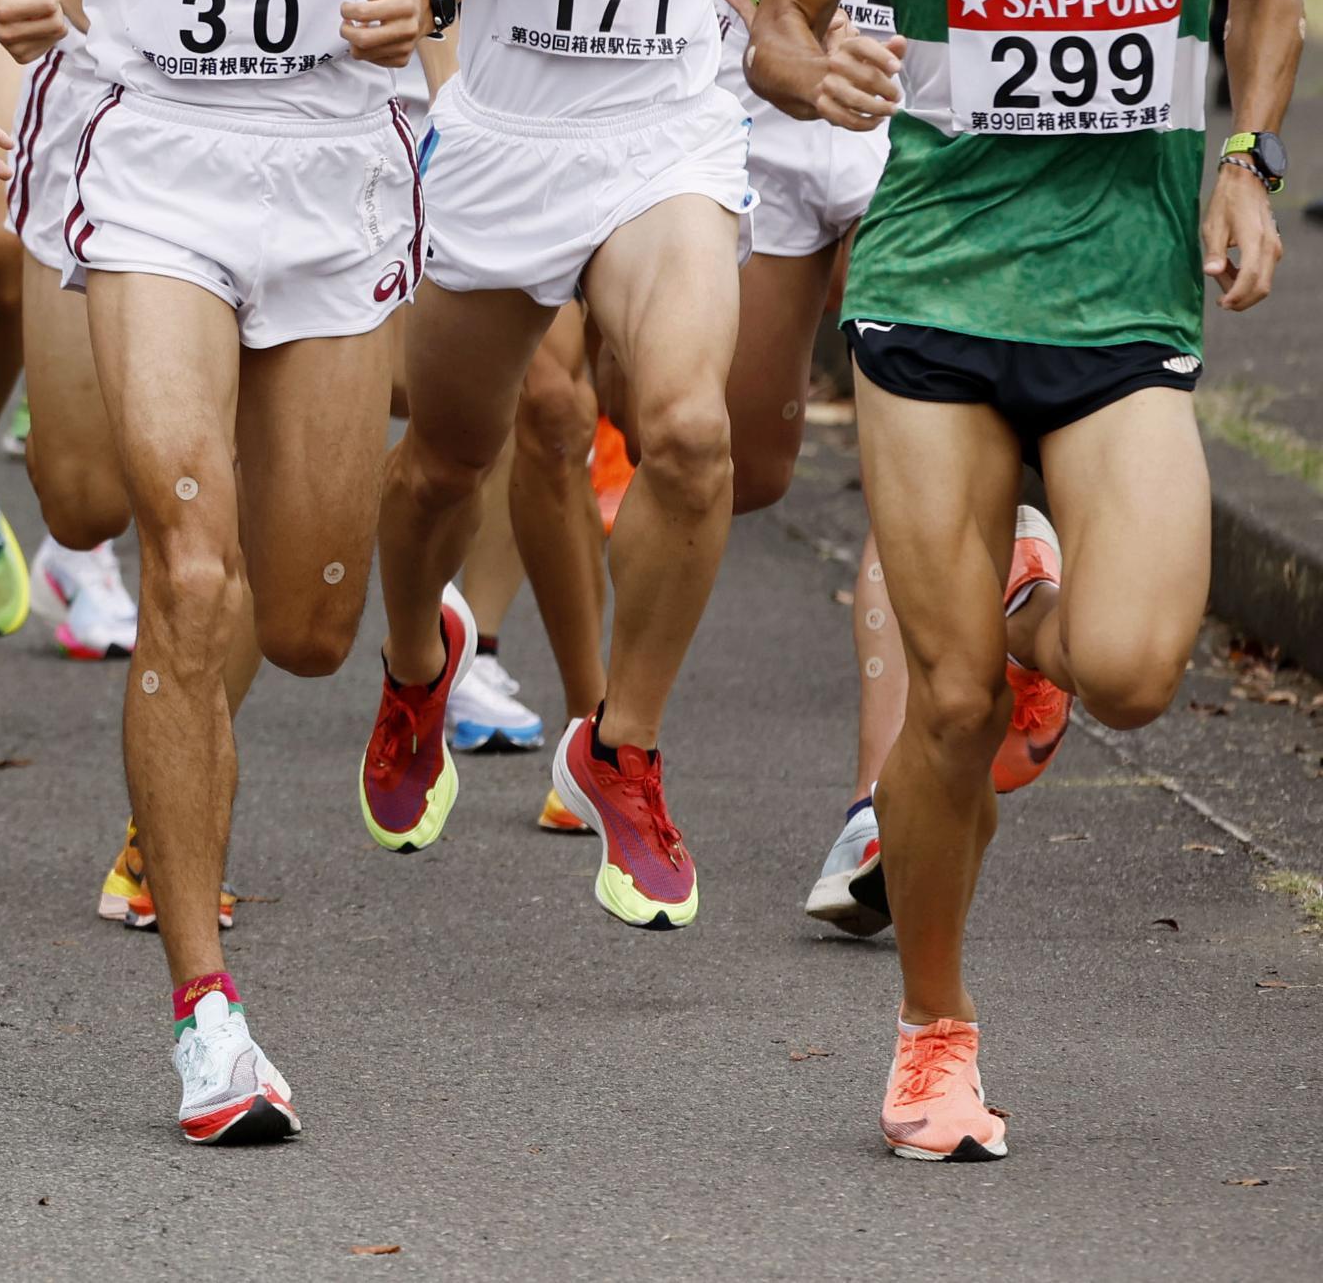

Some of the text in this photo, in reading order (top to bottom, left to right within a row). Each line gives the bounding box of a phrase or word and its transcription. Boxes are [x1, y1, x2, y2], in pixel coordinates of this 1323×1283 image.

[511, 25, 688, 56] 第99回箱根駅伝予選会
[990, 32, 1155, 109] 299
[971, 103, 1171, 132] 第99回箱根駅伝予選会
